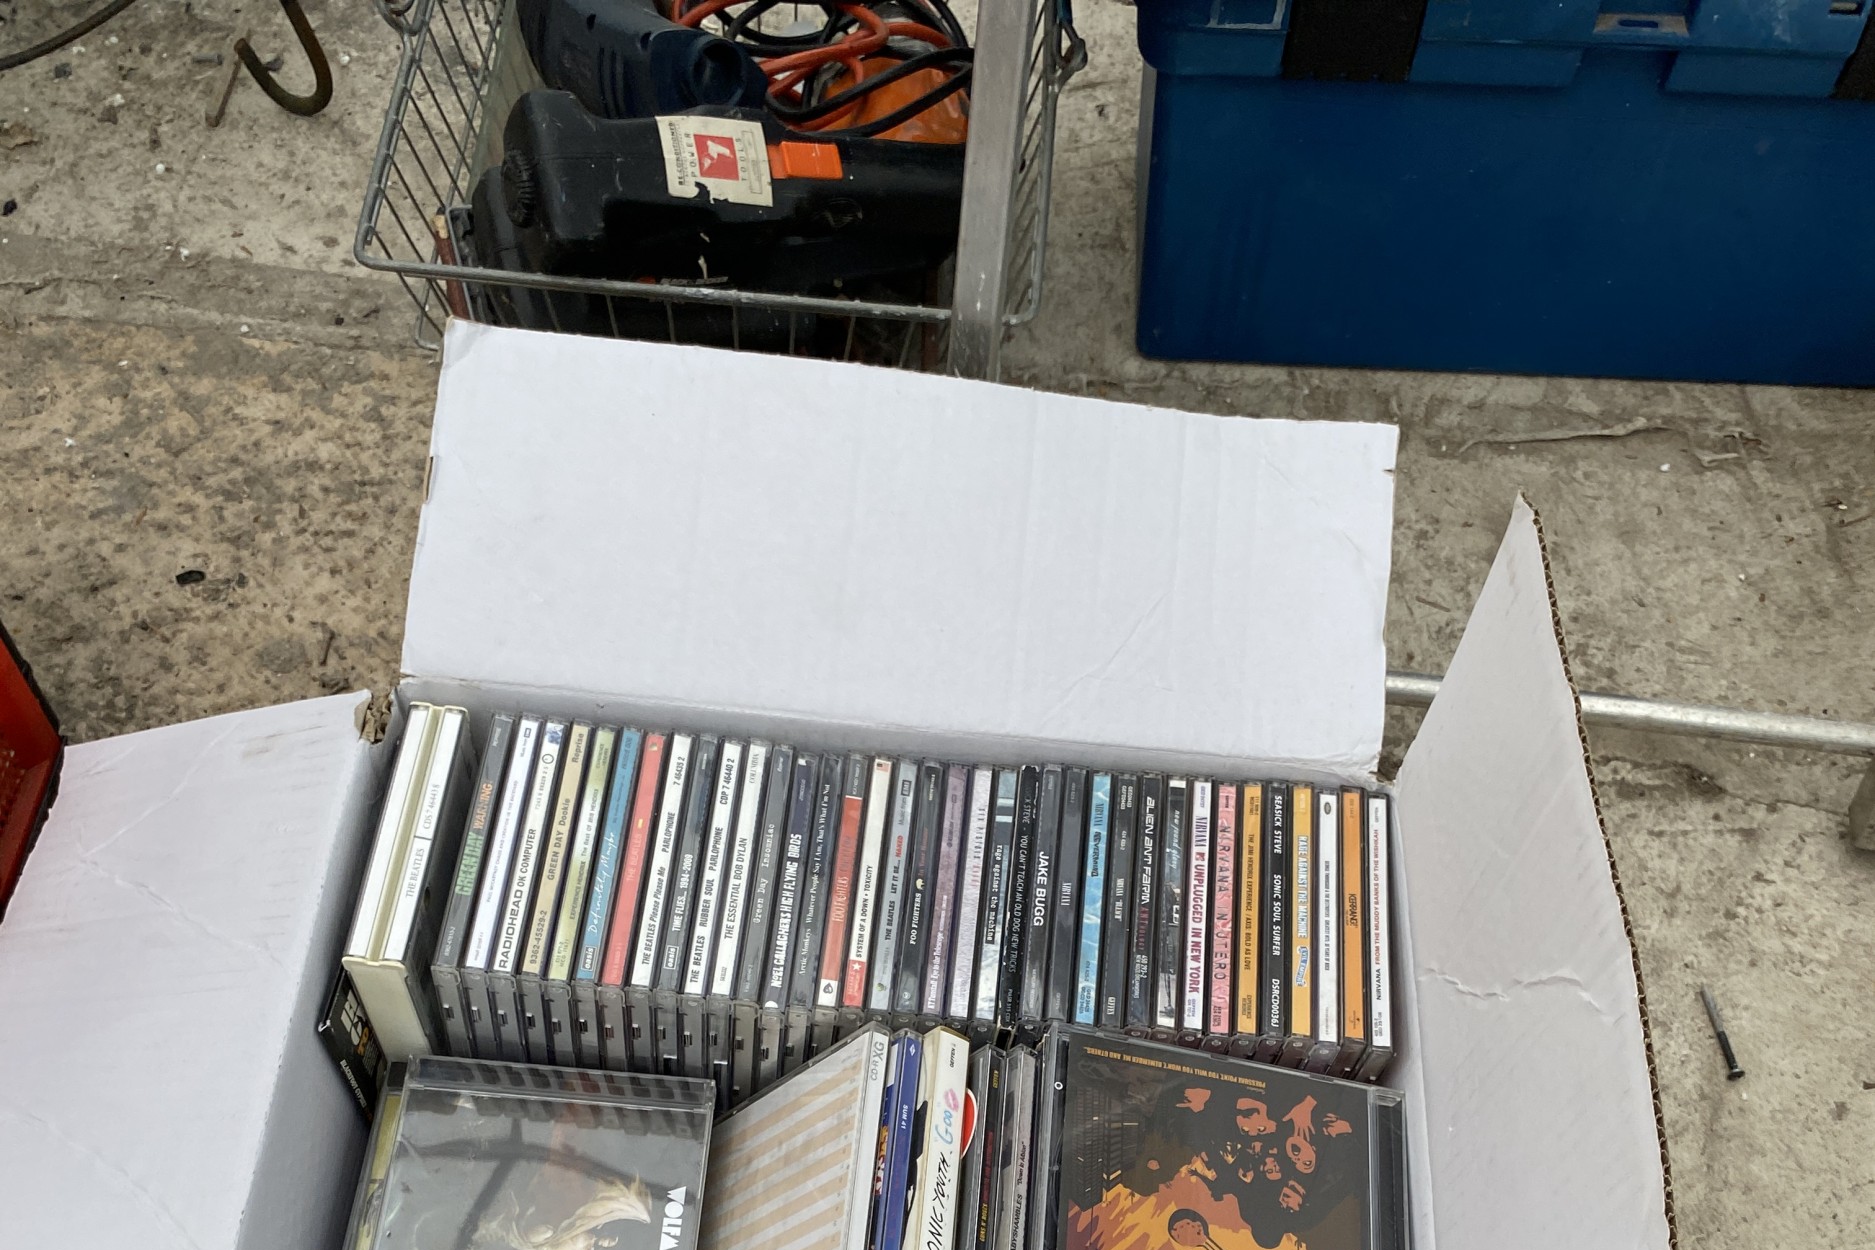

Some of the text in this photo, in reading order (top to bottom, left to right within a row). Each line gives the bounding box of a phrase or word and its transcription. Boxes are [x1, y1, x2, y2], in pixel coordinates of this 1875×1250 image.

[684, 132, 698, 177] POWER
[735, 137, 747, 181] TOOLS
[722, 763, 733, 784] 46440
[719, 790, 729, 805] CDP
[1274, 795, 1282, 826] SEASICK
[1021, 804, 1031, 823] STEVE
[661, 811, 675, 853] PARLOPHONE
[816, 824, 824, 842] That's
[1091, 803, 1104, 876] NIRVANA NEVERMIND
[1169, 825, 1180, 847] found
[1194, 816, 1207, 847] NIRVANA
[1273, 830, 1281, 854] STEVE
[530, 732, 585, 964] 9362-45529-2 GREEN DAY Dookie Reprise
[627, 833, 642, 881] THE BEATLES
[708, 826, 723, 871] PARLOPHONE
[788, 833, 802, 858] BIRDS
[815, 843, 823, 856] Am,
[1141, 796, 1154, 904] ALIEN ANT FARM
[1297, 835, 1307, 855] RAGE
[454, 831, 484, 896] GREEN DAY
[657, 866, 665, 876] Me
[812, 862, 821, 872] Say
[1018, 849, 1026, 870] CAN'T
[1168, 849, 1178, 868] glory
[1217, 825, 1230, 892] NIRVANA
[405, 847, 424, 897] THE BEATLES
[753, 822, 775, 923] Green Day Insomniac
[783, 860, 798, 889] FLYING
[810, 873, 819, 893] People
[864, 865, 873, 891] TOXICITY
[1016, 871, 1024, 891] TEACH
[1297, 857, 1307, 887] AGAINST
[498, 828, 536, 968] RADIOHEAD OK COMPUTER
[654, 877, 664, 899] Please
[704, 877, 714, 896] SOUL
[723, 837, 748, 939] THE ESSENTIAL BOB DYLAN
[836, 875, 848, 904] FIGHTERS
[985, 844, 1003, 940] rage against the machine
[1015, 893, 1022, 902] AN
[1033, 851, 1049, 926] JAKE BUGG
[1060, 882, 1071, 905] NIRVANA
[1191, 864, 1203, 923] UNPLUGGED
[1273, 874, 1281, 898] SONIC
[1297, 890, 1307, 903] THE
[570, 885, 580, 919] EXPERIENCE
[584, 831, 617, 968] oasis Definitely Maybe
[649, 900, 659, 922] Please
[665, 946, 676, 967] oasis
[671, 914, 682, 931] TIME
[679, 853, 693, 889] 1994-2009
[699, 898, 711, 927] RUBBER
[779, 890, 794, 911] HIGH
[806, 895, 815, 923] Whatever
[861, 898, 869, 916] DOWN
[834, 905, 844, 921] FOO
[886, 900, 895, 926] BEATLES
[909, 892, 921, 944] FOO FIGHTERS
[1297, 905, 1307, 937] MACHINE
[644, 923, 656, 951] BEATLES
[859, 923, 866, 931] OF
[1191, 927, 1201, 937] IN
[1272, 925, 1280, 955] SURFER
[693, 935, 705, 965] BEATLES
[801, 928, 812, 954] Monkeys
[855, 933, 865, 957] SYSTEM
[1010, 933, 1018, 948] NEW
[1190, 940, 1200, 962] NEW
[641, 952, 651, 965] THE
[798, 956, 807, 975] Arctic
[1008, 950, 1017, 972] TRICKS
[1214, 932, 1227, 980] UTERO
[690, 969, 699, 983] THE
[1188, 966, 1199, 993] YORK
[1106, 996, 1115, 1014] GEFFEN
[1270, 978, 1279, 1027] DSRCD0036J
[869, 1041, 884, 1081] CD-R XG
[1131, 1055, 1162, 1066] REMEMBER
[1207, 1070, 1219, 1078] YOU
[1237, 1077, 1265, 1087] PRESSURE
[932, 1151, 951, 1208] YOUTH
